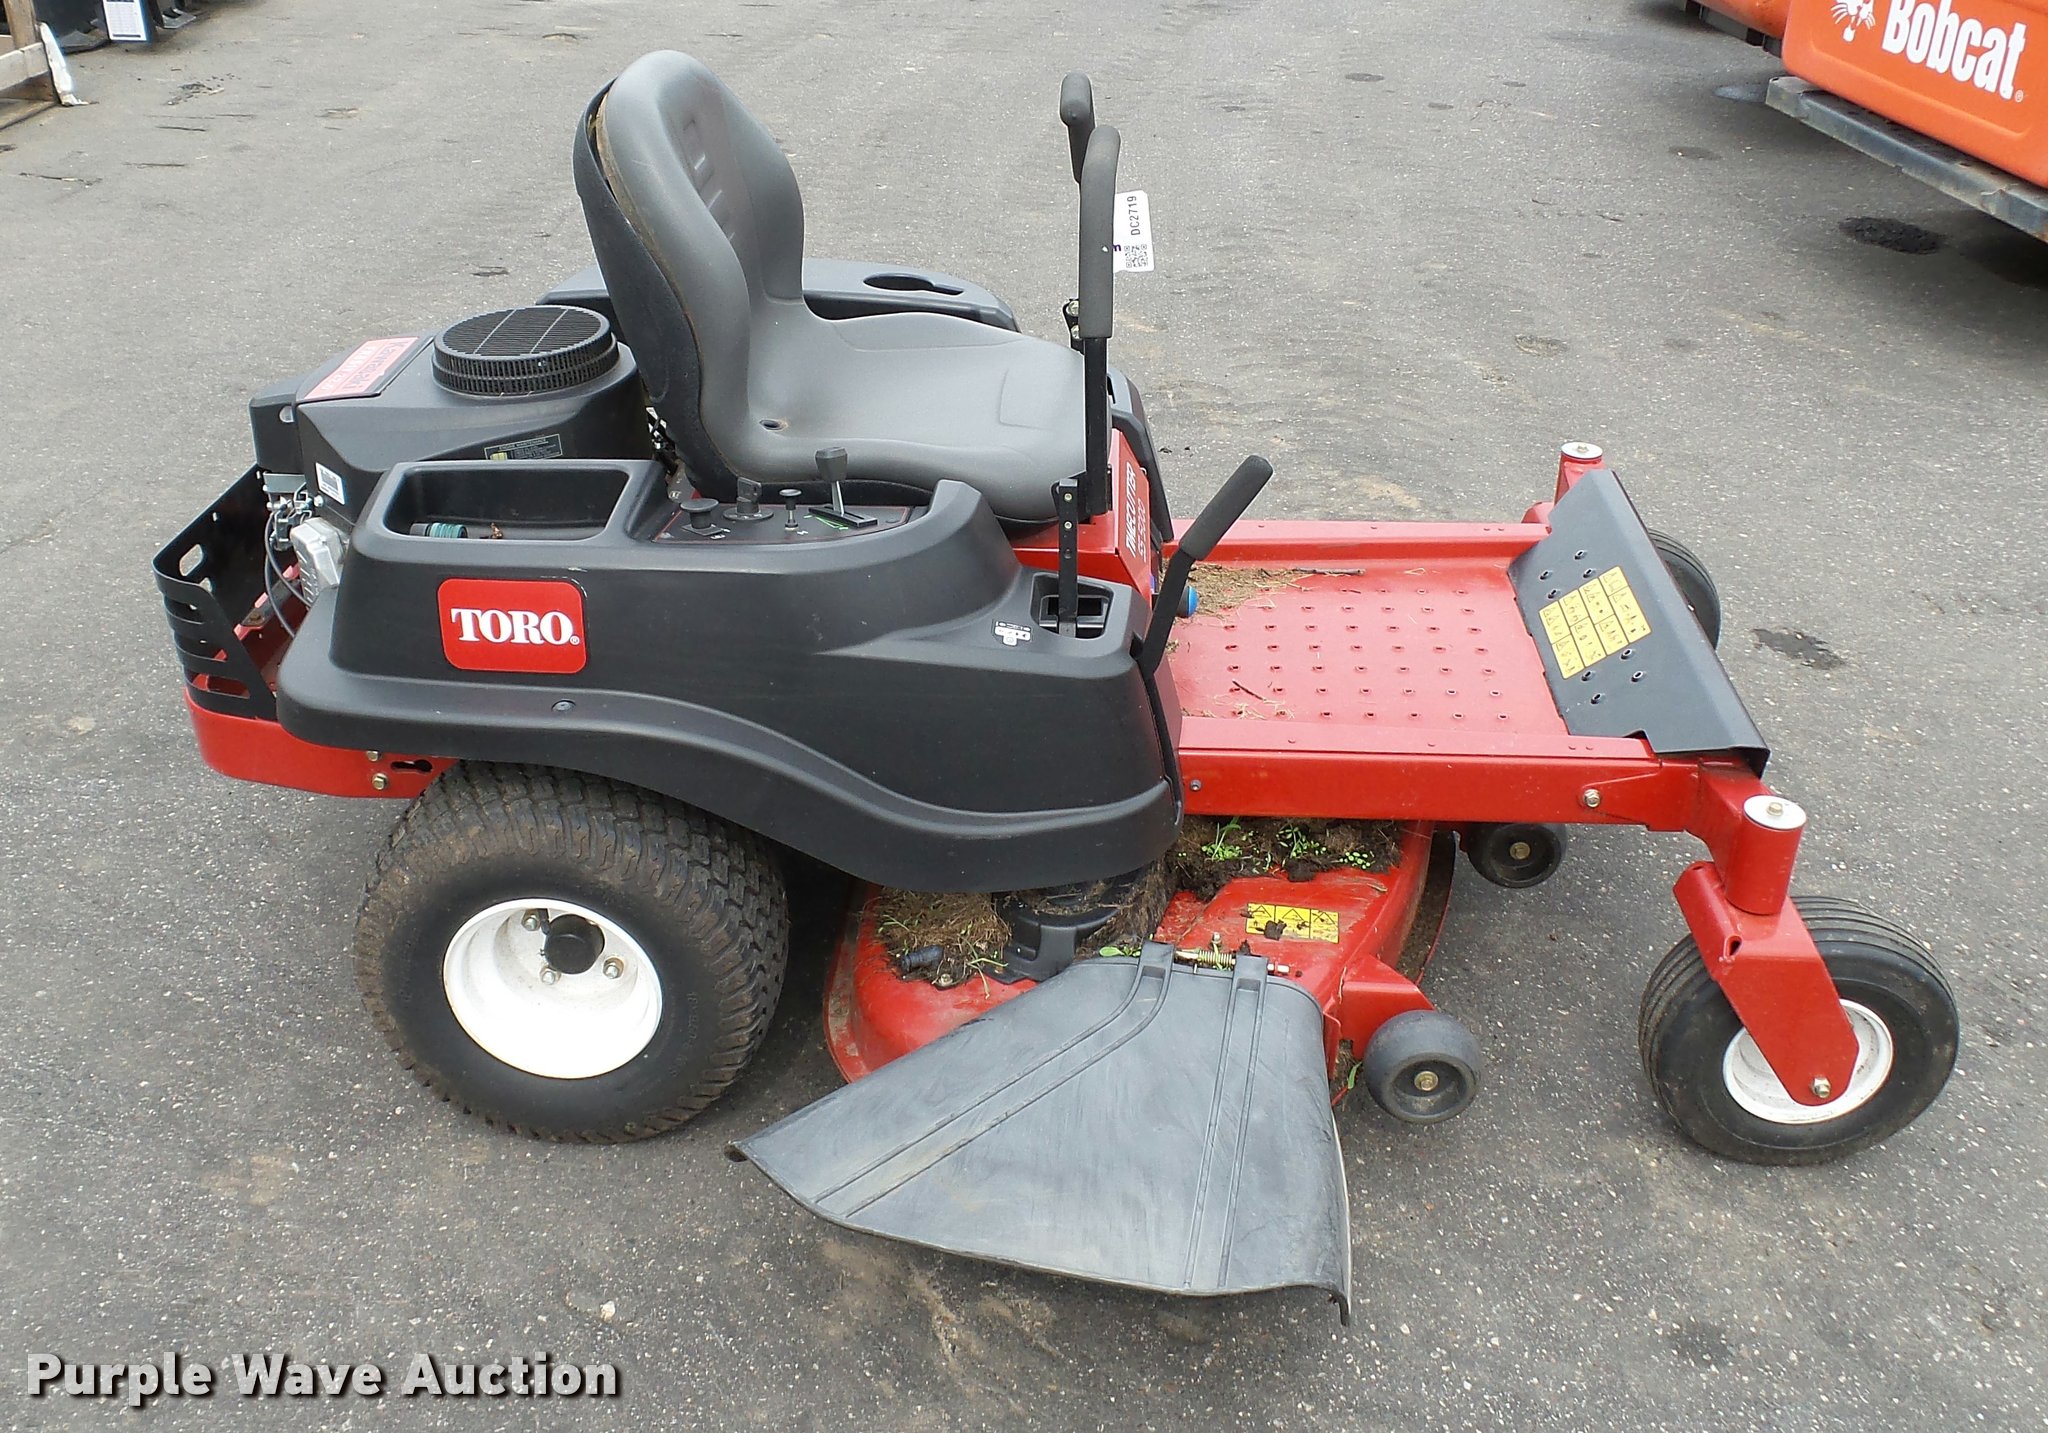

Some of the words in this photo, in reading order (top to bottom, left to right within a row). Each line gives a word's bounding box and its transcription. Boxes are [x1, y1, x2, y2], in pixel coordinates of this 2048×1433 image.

[1882, 0, 2027, 100] Bobcat
[1127, 195, 1141, 236] DC2719
[450, 608, 574, 646] TORO
